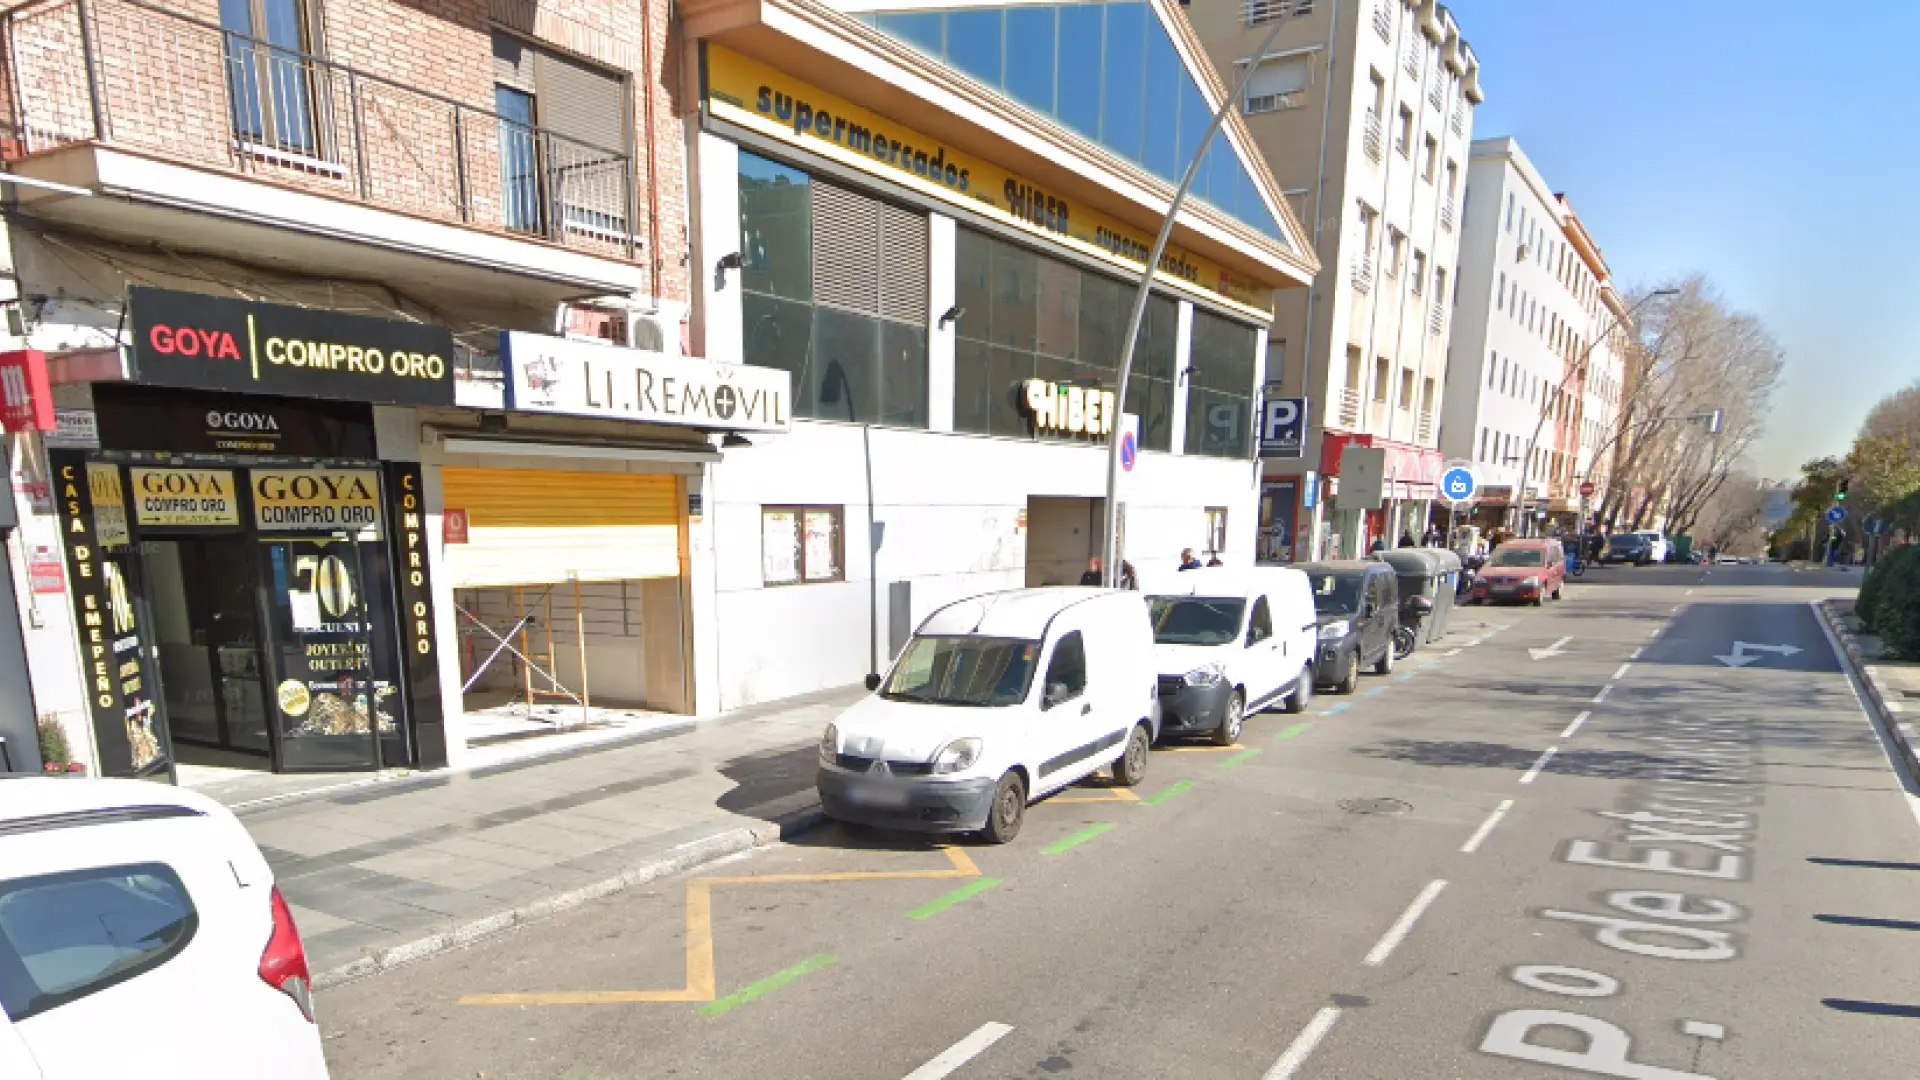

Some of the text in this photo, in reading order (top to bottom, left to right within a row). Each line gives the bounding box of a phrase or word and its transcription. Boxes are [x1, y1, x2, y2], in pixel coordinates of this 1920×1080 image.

[757, 85, 970, 191] supermercados
[149, 323, 242, 361] GOYA
[266, 336, 445, 380] COMPRO ORO
[224, 411, 279, 431] GOYA
[1264, 400, 1298, 440] P
[142, 472, 223, 496] GOYA
[257, 475, 373, 500] GOYA
[61, 464, 86, 533] CASA
[75, 545, 93, 577] DE
[145, 497, 226, 512] COMPRO ORO
[261, 505, 375, 524] COMPRO ORO
[402, 473, 430, 655] COMPRO ORO
[1543, 889, 1741, 961] de
